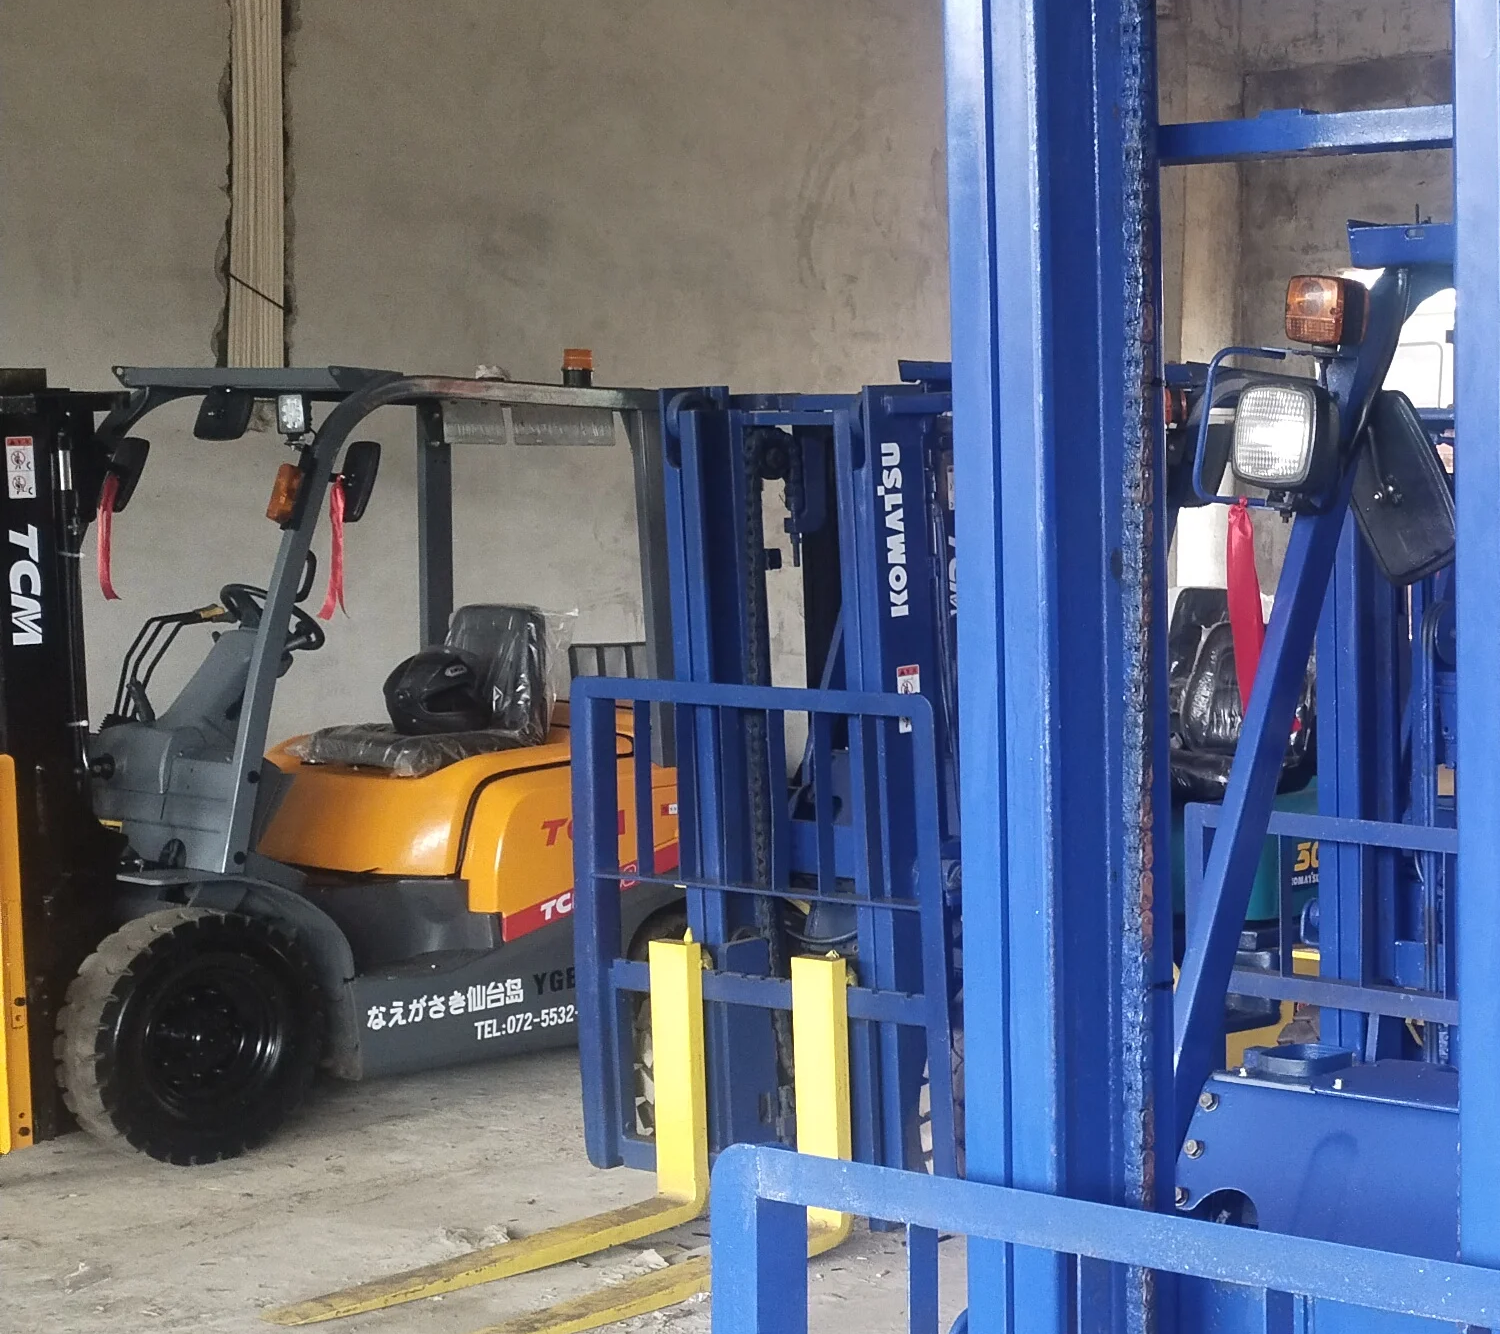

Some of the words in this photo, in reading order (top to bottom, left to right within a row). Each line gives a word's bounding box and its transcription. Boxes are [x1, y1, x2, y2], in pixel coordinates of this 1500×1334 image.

[8, 523, 43, 646] TCM
[877, 442, 909, 618] KOMATSU
[540, 892, 574, 921] TC
